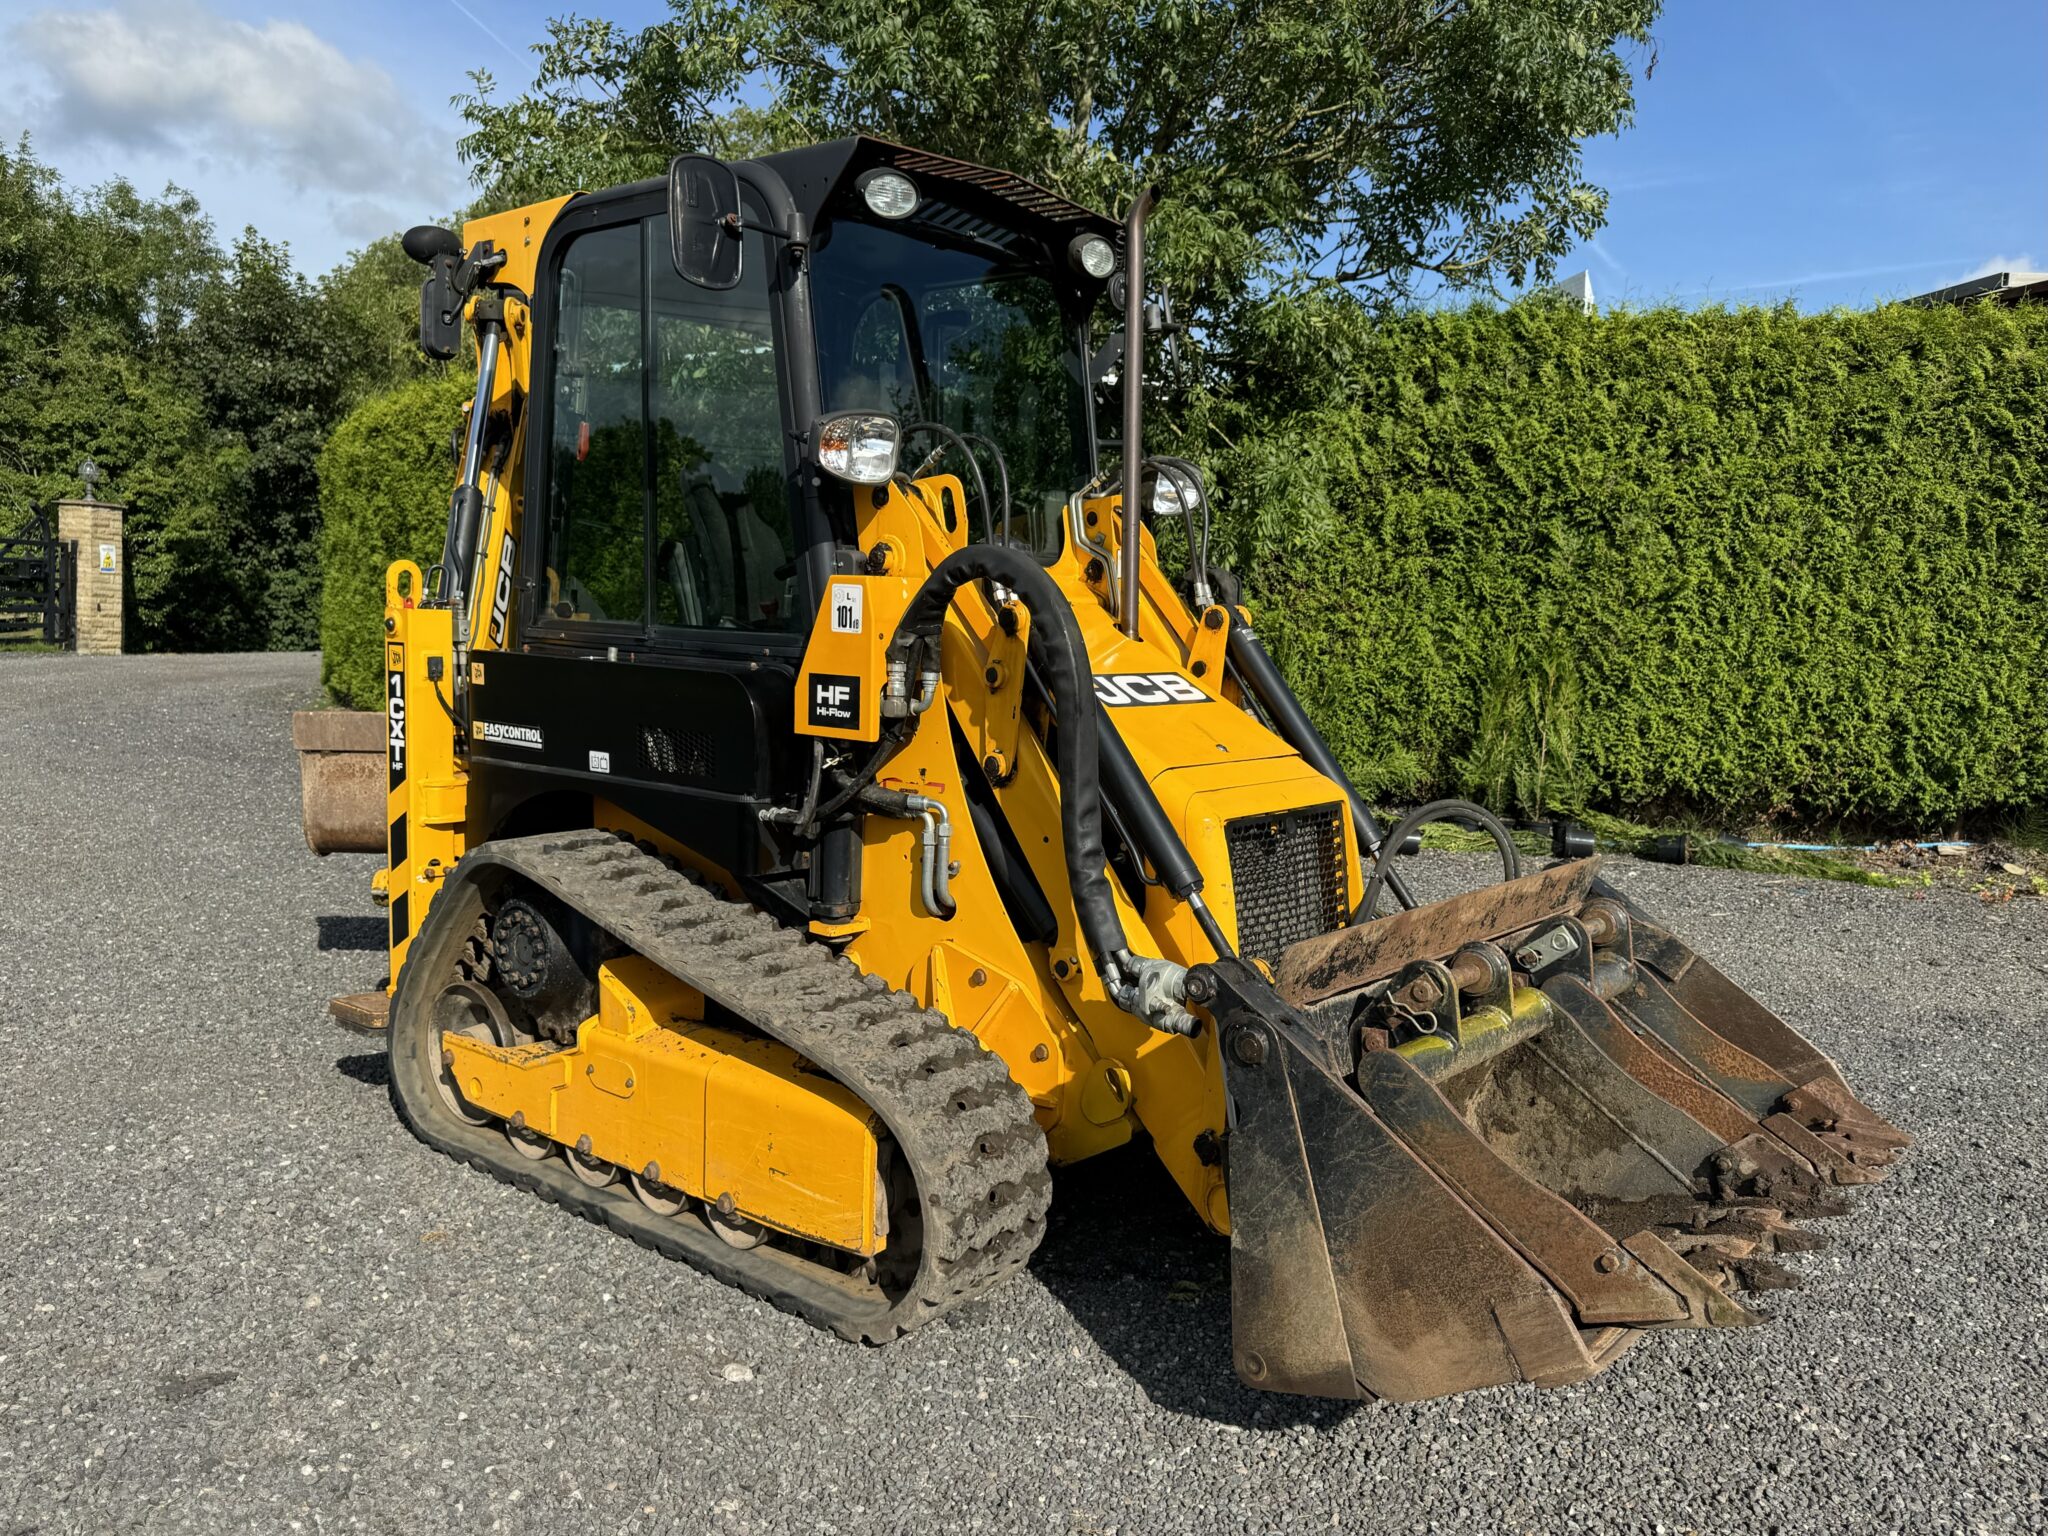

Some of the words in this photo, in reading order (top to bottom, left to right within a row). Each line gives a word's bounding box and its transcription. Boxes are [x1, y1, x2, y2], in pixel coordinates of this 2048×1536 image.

[493, 533, 516, 645] JCB
[836, 605, 853, 629] 101
[816, 684, 851, 706] HF
[1093, 674, 1207, 705] JCB
[389, 673, 406, 762] 1CXT
[816, 706, 851, 719] Hi-Flow
[484, 722, 543, 743] EASYCONTROL
[392, 761, 404, 771] HF
